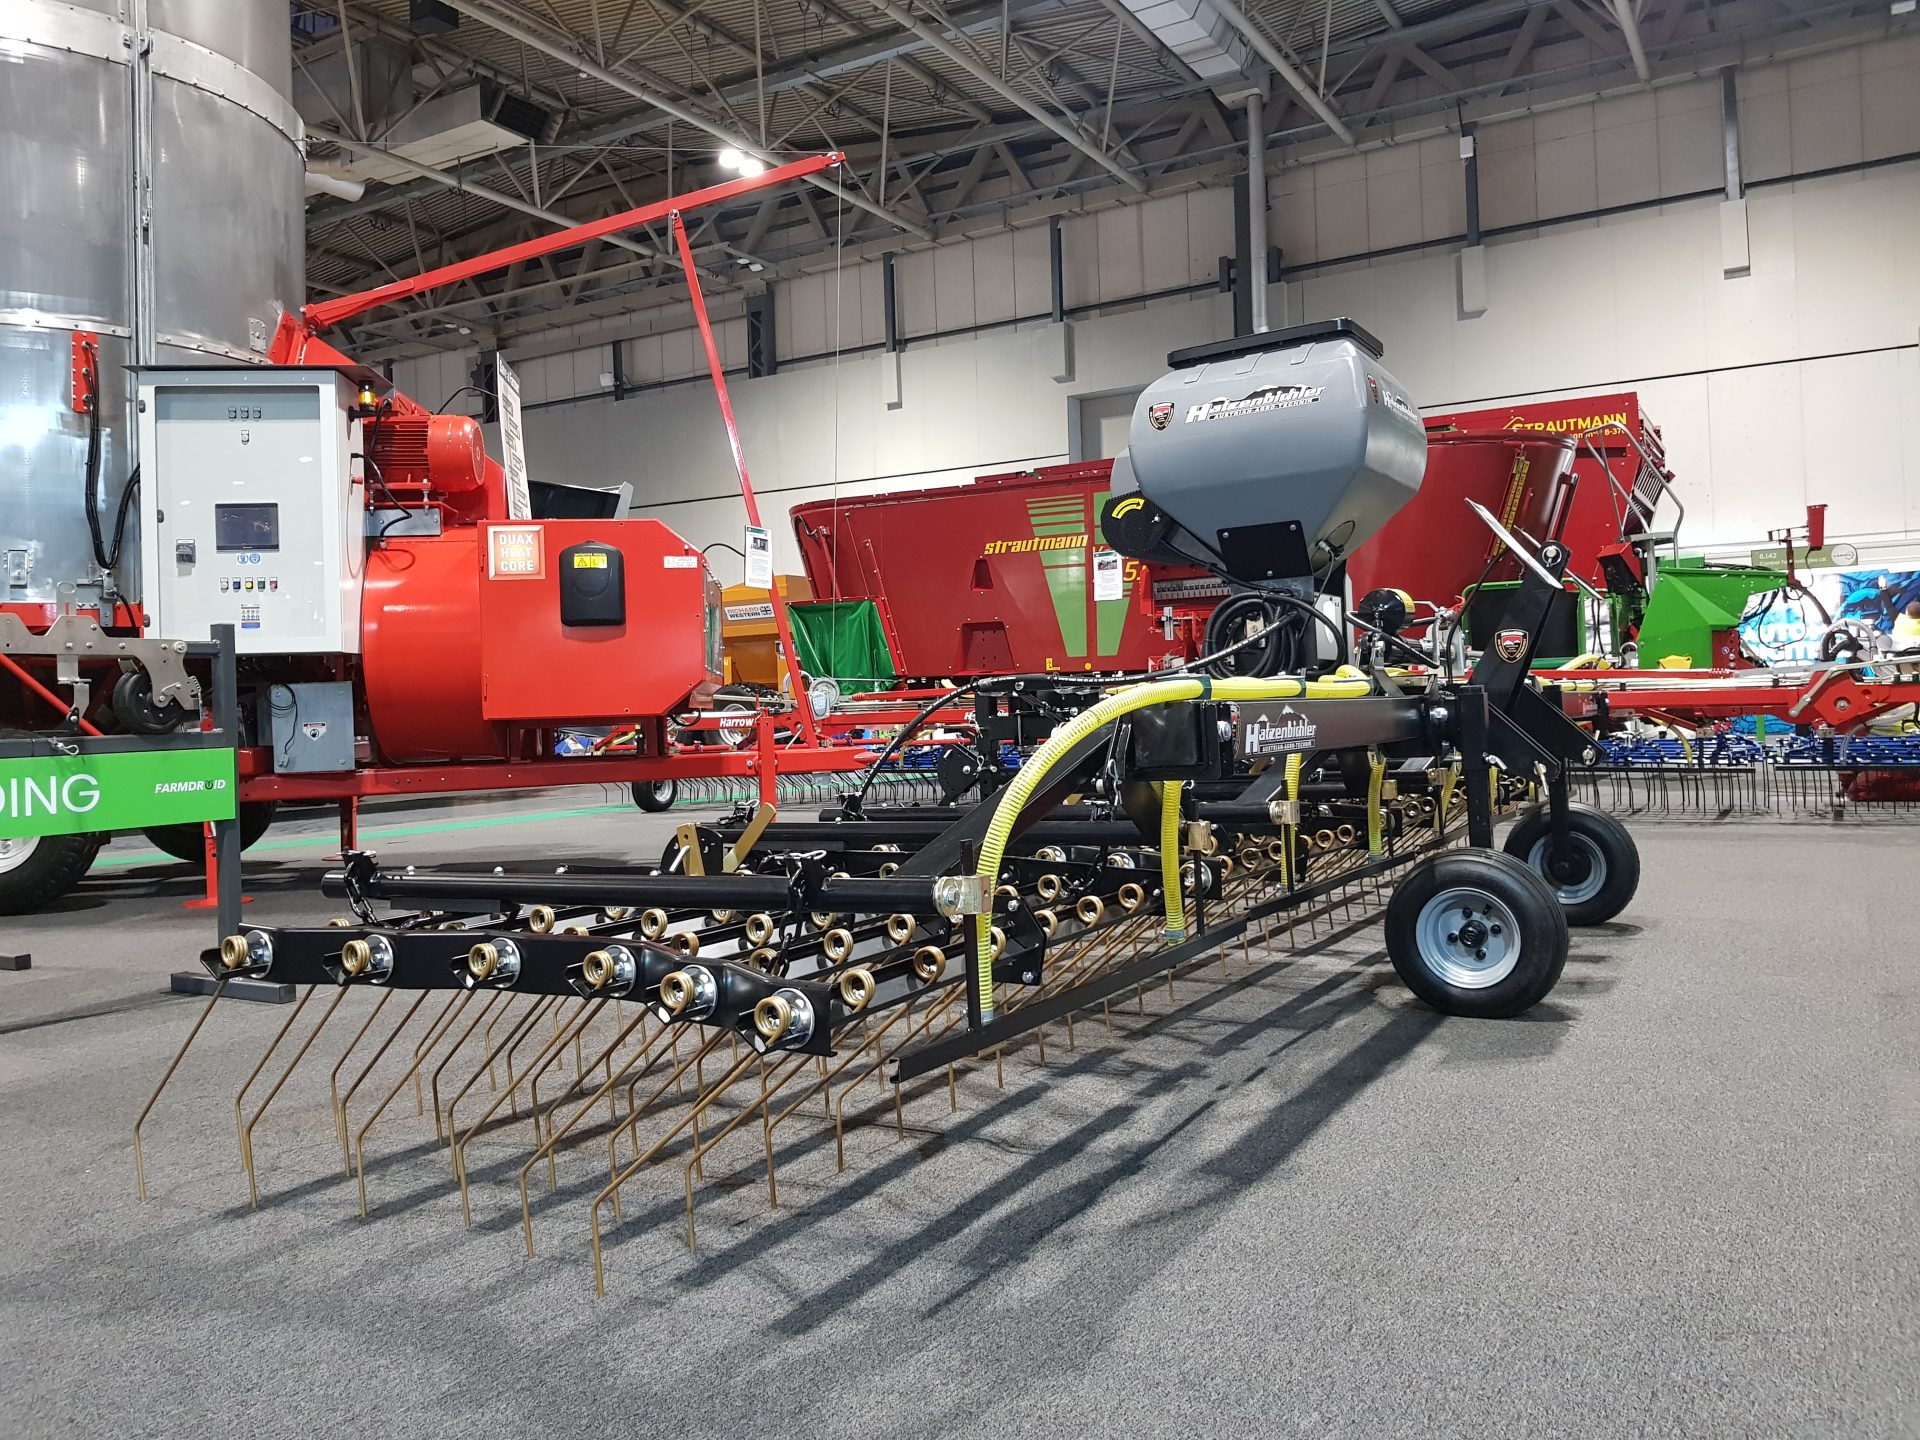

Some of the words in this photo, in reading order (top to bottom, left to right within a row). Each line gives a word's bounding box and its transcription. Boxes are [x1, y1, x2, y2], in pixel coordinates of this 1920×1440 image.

[1185, 385, 1327, 424] Hatzenbichler
[1604, 427, 1626, 436] 8-37
[499, 534, 534, 545] DUAX
[984, 534, 1089, 555] strautmann
[501, 547, 532, 558] HEAT
[501, 560, 534, 571] CORE
[720, 717, 754, 728] Harrow
[1245, 719, 1317, 755] Hatzenbichler
[155, 779, 226, 794] FARMDROID
